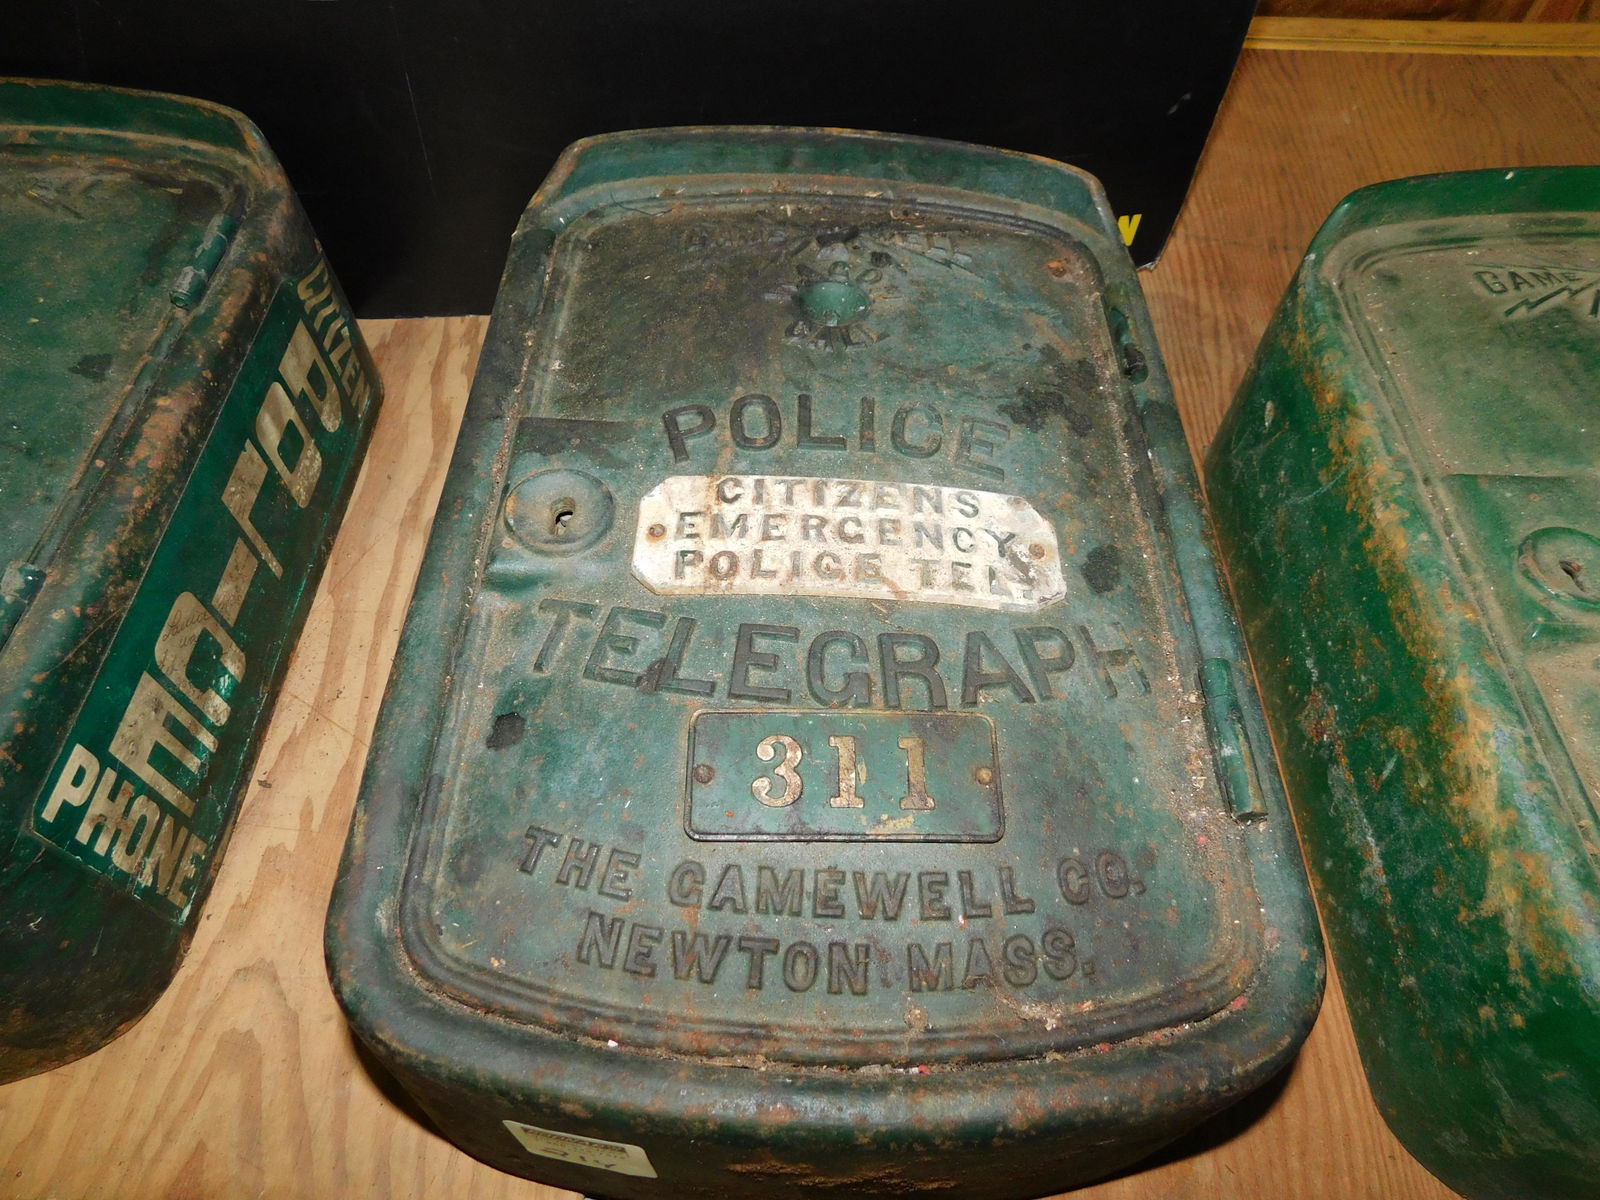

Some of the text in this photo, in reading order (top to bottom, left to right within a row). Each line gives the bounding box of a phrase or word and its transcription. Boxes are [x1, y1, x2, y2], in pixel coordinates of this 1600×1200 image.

[1473, 270, 1583, 294] GAME
[297, 257, 372, 418] CITIZEN
[662, 393, 1011, 483] POLICE
[674, 511, 1016, 559] EMERGENCY
[715, 477, 980, 519] CITIZENS
[674, 550, 882, 584] POLICE
[533, 599, 1152, 710] TELEGRAPH
[751, 735, 936, 811] 311
[42, 743, 207, 908] PHONE
[516, 827, 1146, 921] THE GAMEWELL CO.
[575, 909, 1094, 996] NEWTON MASS.
